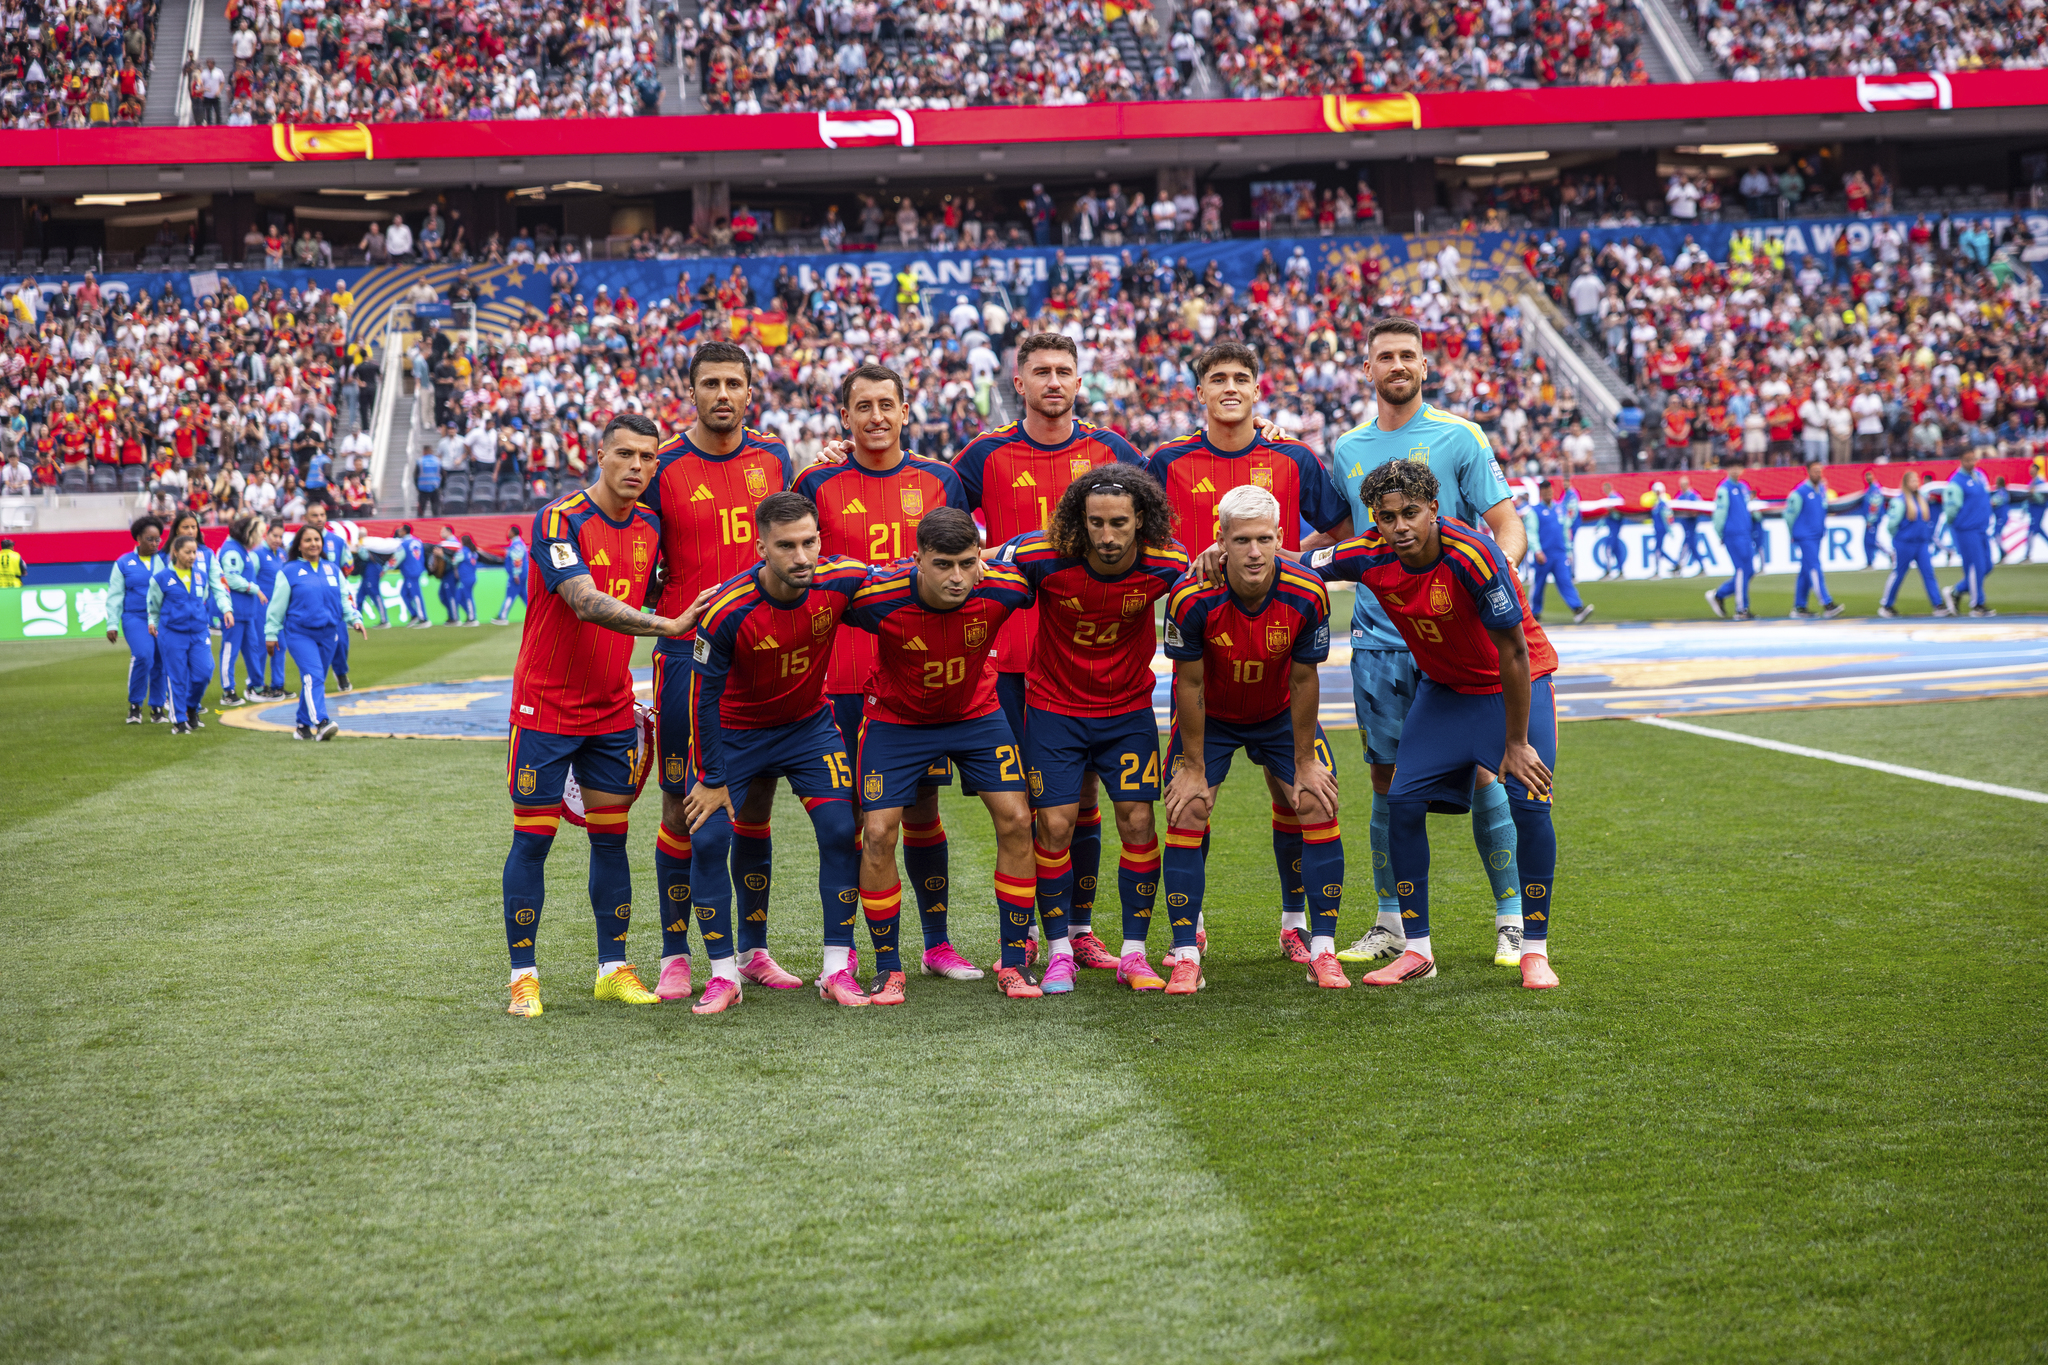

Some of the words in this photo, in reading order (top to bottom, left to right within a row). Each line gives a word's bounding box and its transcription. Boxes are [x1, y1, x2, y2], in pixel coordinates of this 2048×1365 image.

[798, 261, 893, 293] LOS
[719, 506, 752, 545] 16
[870, 522, 901, 560] 21
[608, 578, 631, 602] 12
[1073, 620, 1120, 646] 24
[1406, 616, 1443, 643] 19
[781, 646, 809, 678] 15
[924, 656, 965, 687] 20
[1232, 659, 1264, 683] 10
[822, 751, 853, 788] 15
[1120, 751, 1160, 790] 24
